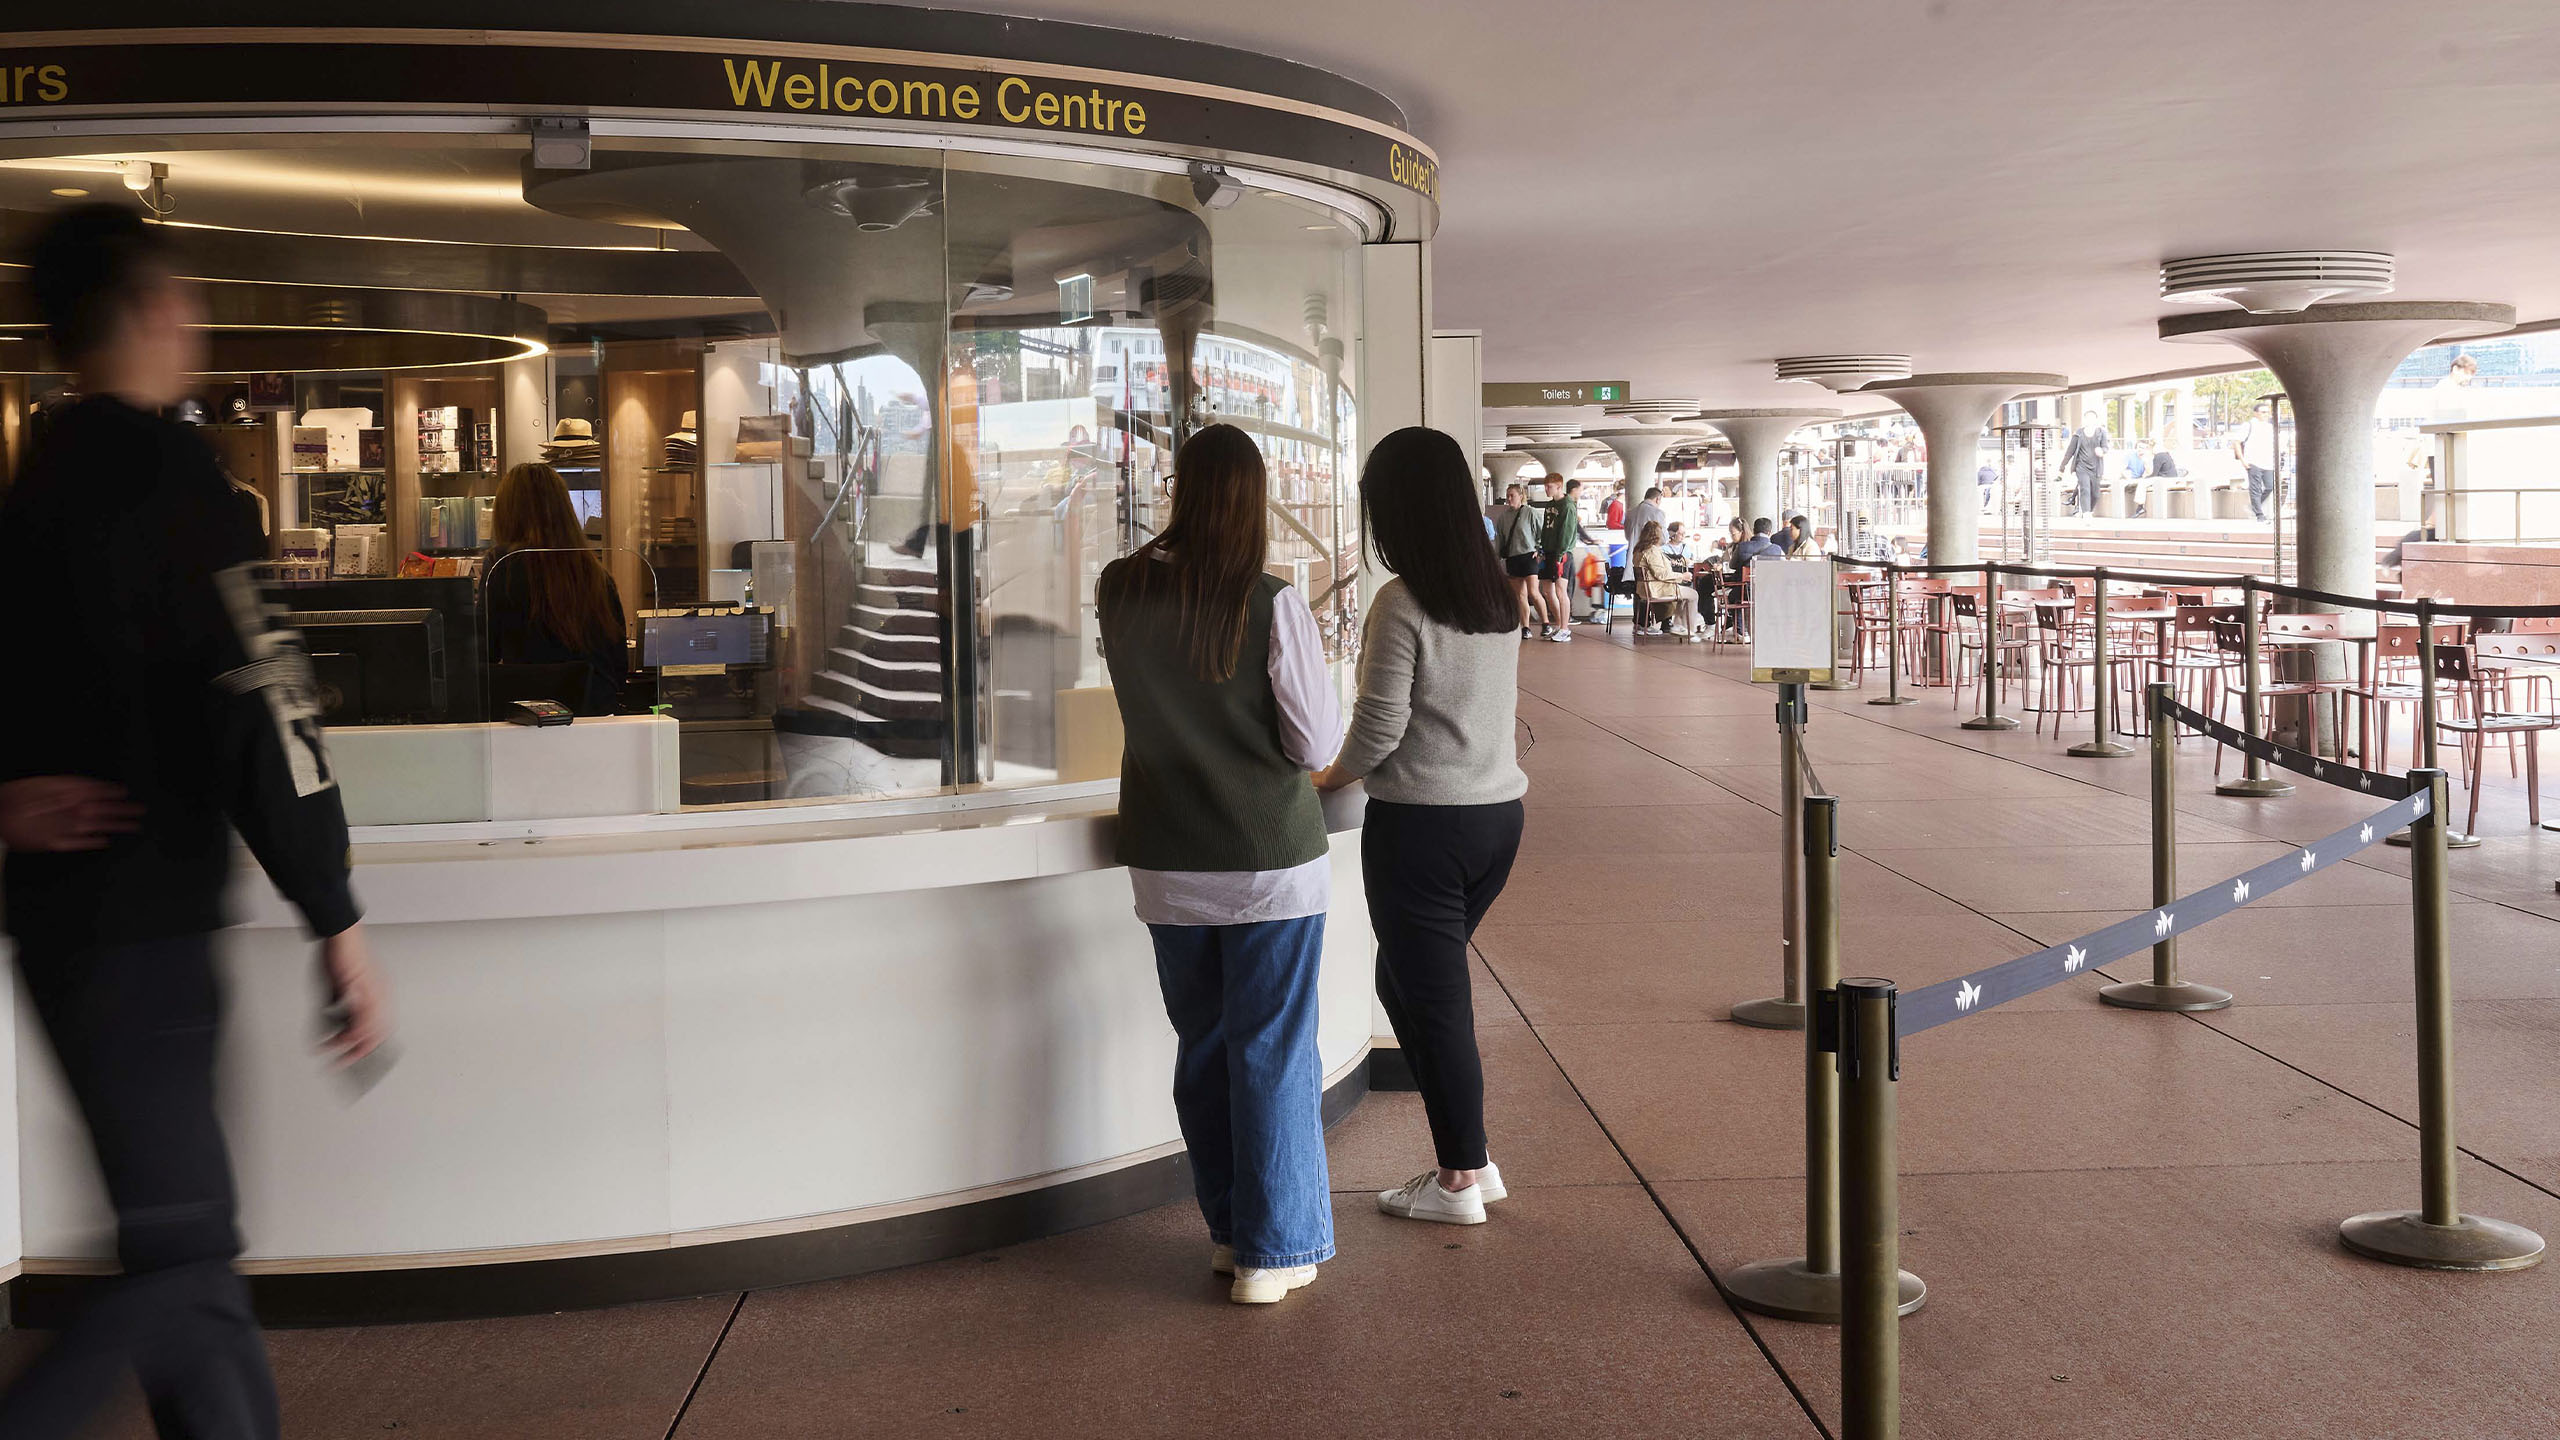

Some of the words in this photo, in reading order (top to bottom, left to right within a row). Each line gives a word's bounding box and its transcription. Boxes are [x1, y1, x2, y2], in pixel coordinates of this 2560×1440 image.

[723, 59, 981, 119] Welcome
[997, 77, 1147, 136] Centre
[1390, 143, 1430, 196] Guided
[1541, 389, 1571, 400] Toilets
